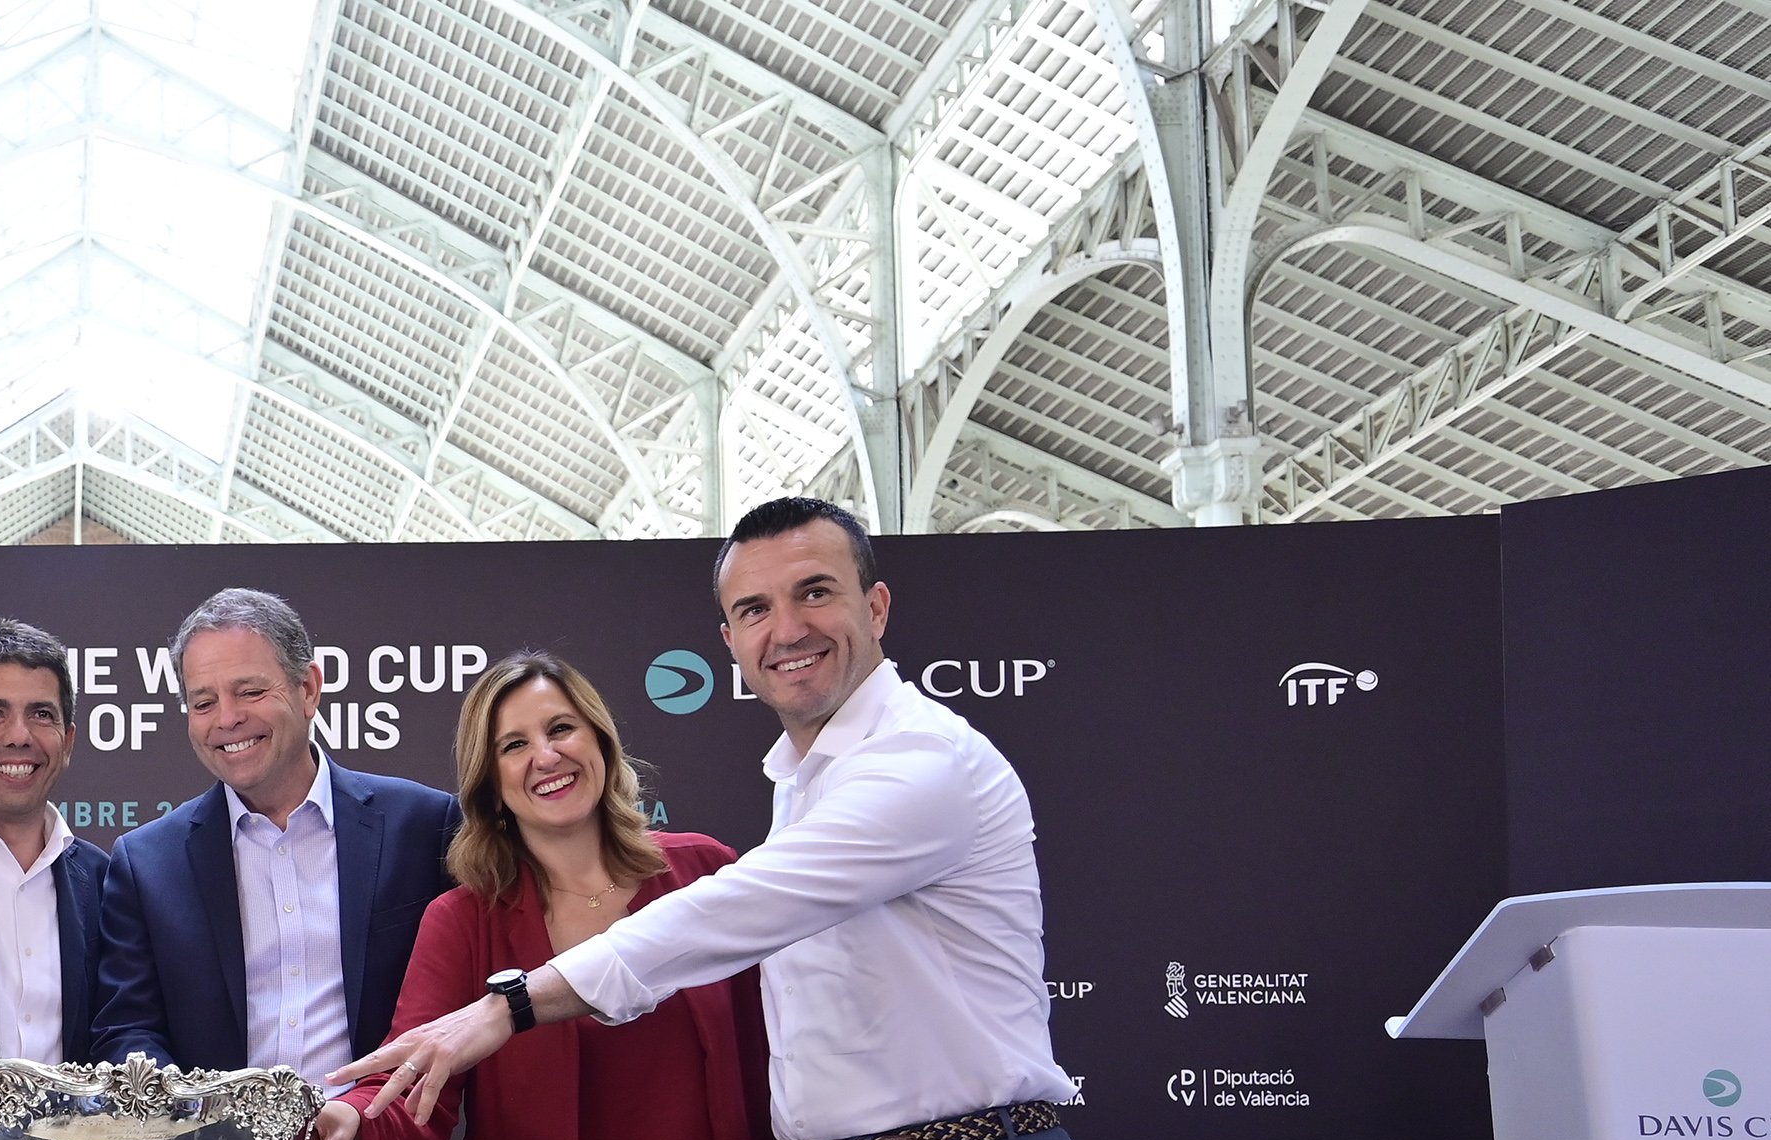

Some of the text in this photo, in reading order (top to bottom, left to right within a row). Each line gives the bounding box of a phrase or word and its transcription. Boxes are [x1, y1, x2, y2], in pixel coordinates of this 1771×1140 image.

[368, 644, 489, 696] CUP
[1285, 675, 1349, 707] ITF
[88, 703, 165, 751] OF
[1046, 980, 1093, 999] CUP
[1193, 973, 1309, 988] GENERALITAT
[1195, 990, 1306, 1005] VALENCIANA
[1213, 1068, 1295, 1089] Diputació
[1213, 1090, 1310, 1107] de València
[1638, 1115, 1734, 1138] DAVIS
